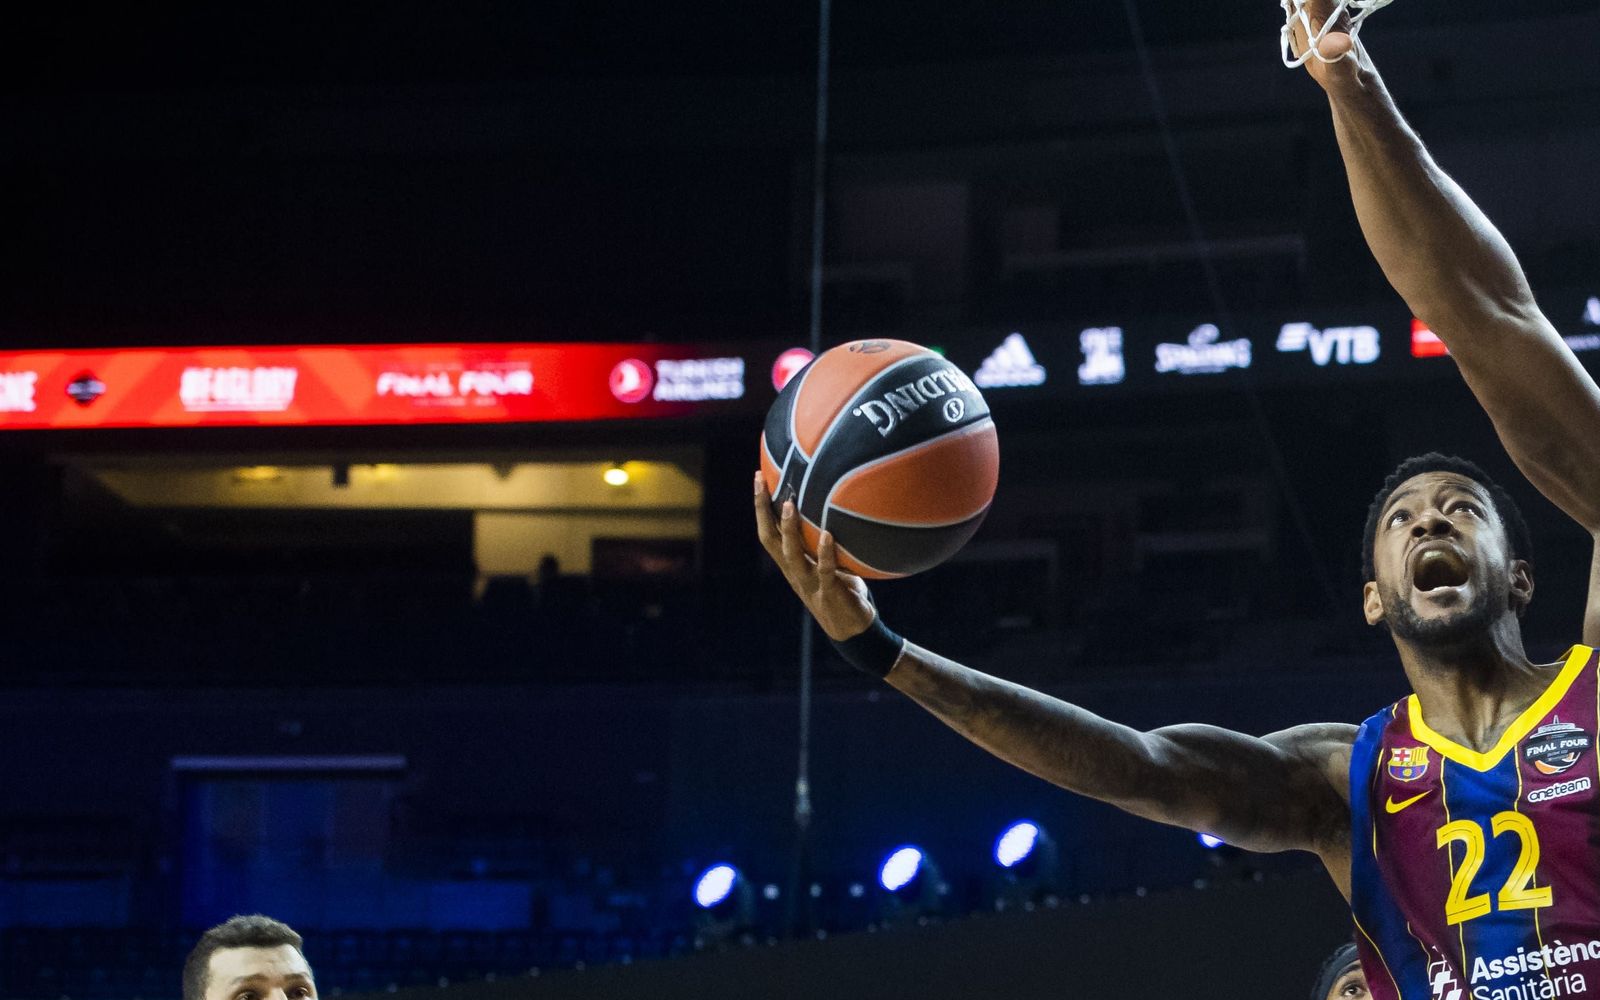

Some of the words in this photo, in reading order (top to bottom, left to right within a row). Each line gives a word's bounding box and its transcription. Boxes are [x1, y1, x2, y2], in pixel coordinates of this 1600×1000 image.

[1308, 326, 1381, 366] VTB
[377, 371, 452, 397] FINAL
[459, 370, 534, 396] FOUR
[1526, 742, 1557, 757] FINAL
[1560, 738, 1589, 748] FOUR
[1437, 811, 1553, 926] 22
